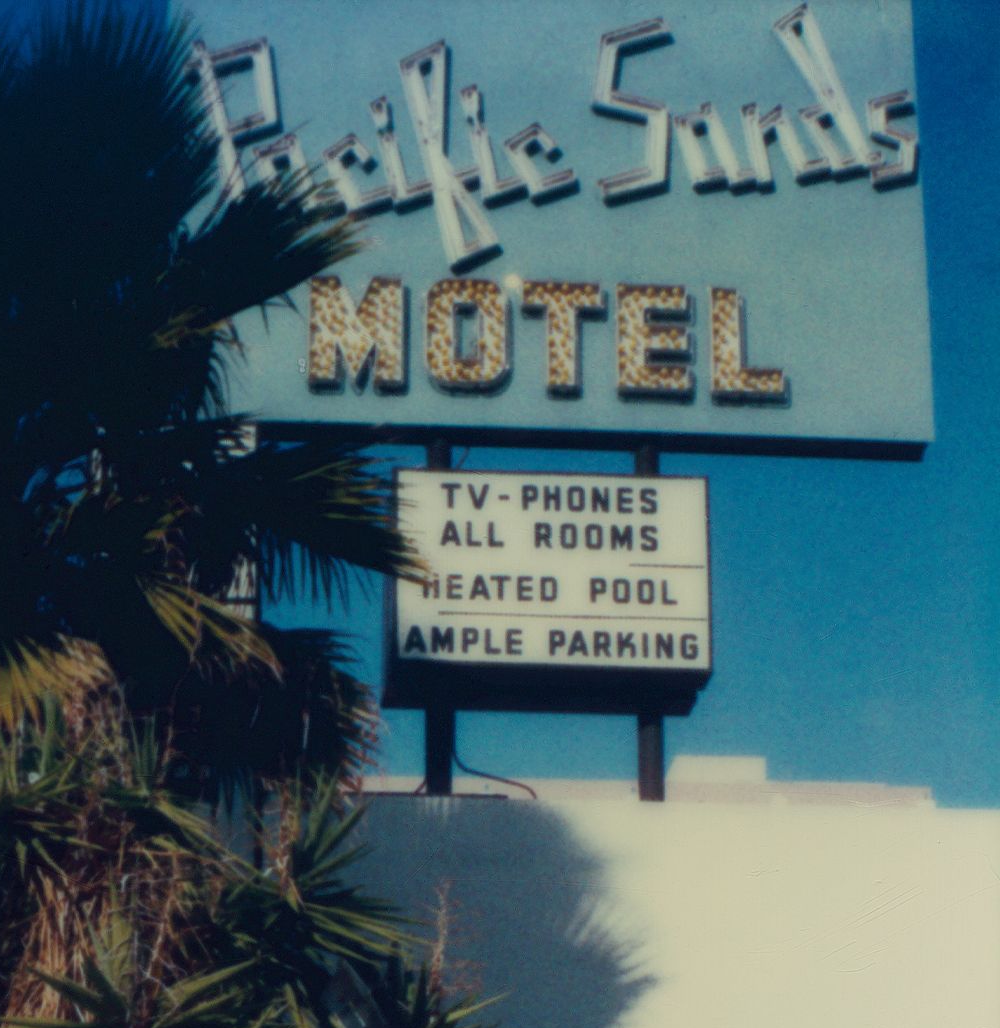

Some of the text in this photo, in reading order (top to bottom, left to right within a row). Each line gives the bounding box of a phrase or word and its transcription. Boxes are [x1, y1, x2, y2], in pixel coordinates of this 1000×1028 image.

[593, 3, 917, 206] Sands
[308, 275, 790, 400] MOTEL
[440, 521, 659, 552] ALL ROOMS
[421, 573, 678, 606] HEATED POOL
[404, 625, 700, 660] AMPLE PARKING
